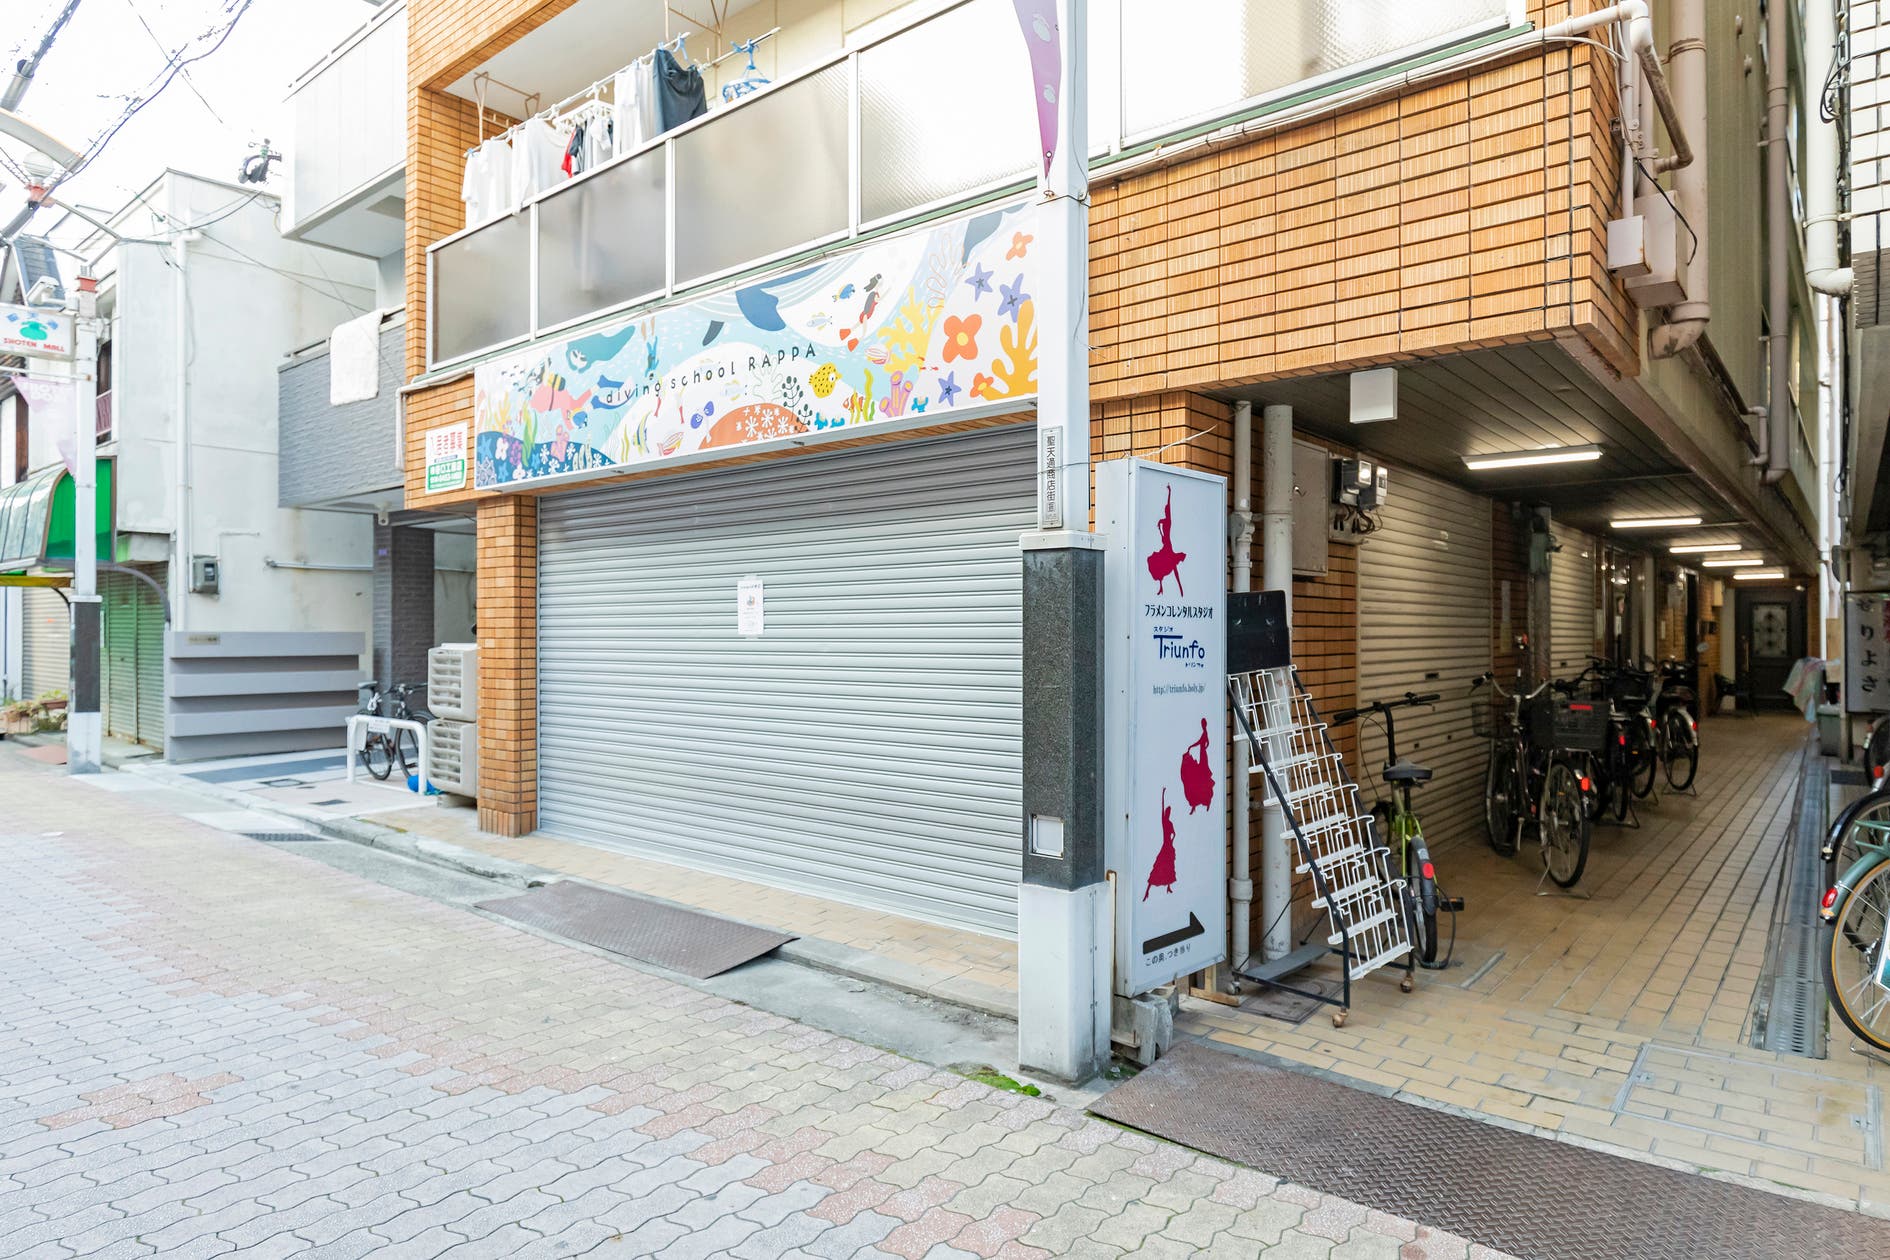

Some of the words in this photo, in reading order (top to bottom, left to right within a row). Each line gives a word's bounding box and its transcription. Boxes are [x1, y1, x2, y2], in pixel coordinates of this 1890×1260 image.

[44, 344, 65, 352] MALL
[607, 381, 661, 403] diving
[670, 361, 736, 389] school
[748, 342, 816, 371] RAPPA
[1144, 604, 1213, 619] フラメンコレンタルスタジオ
[1153, 634, 1206, 660] Triunfo
